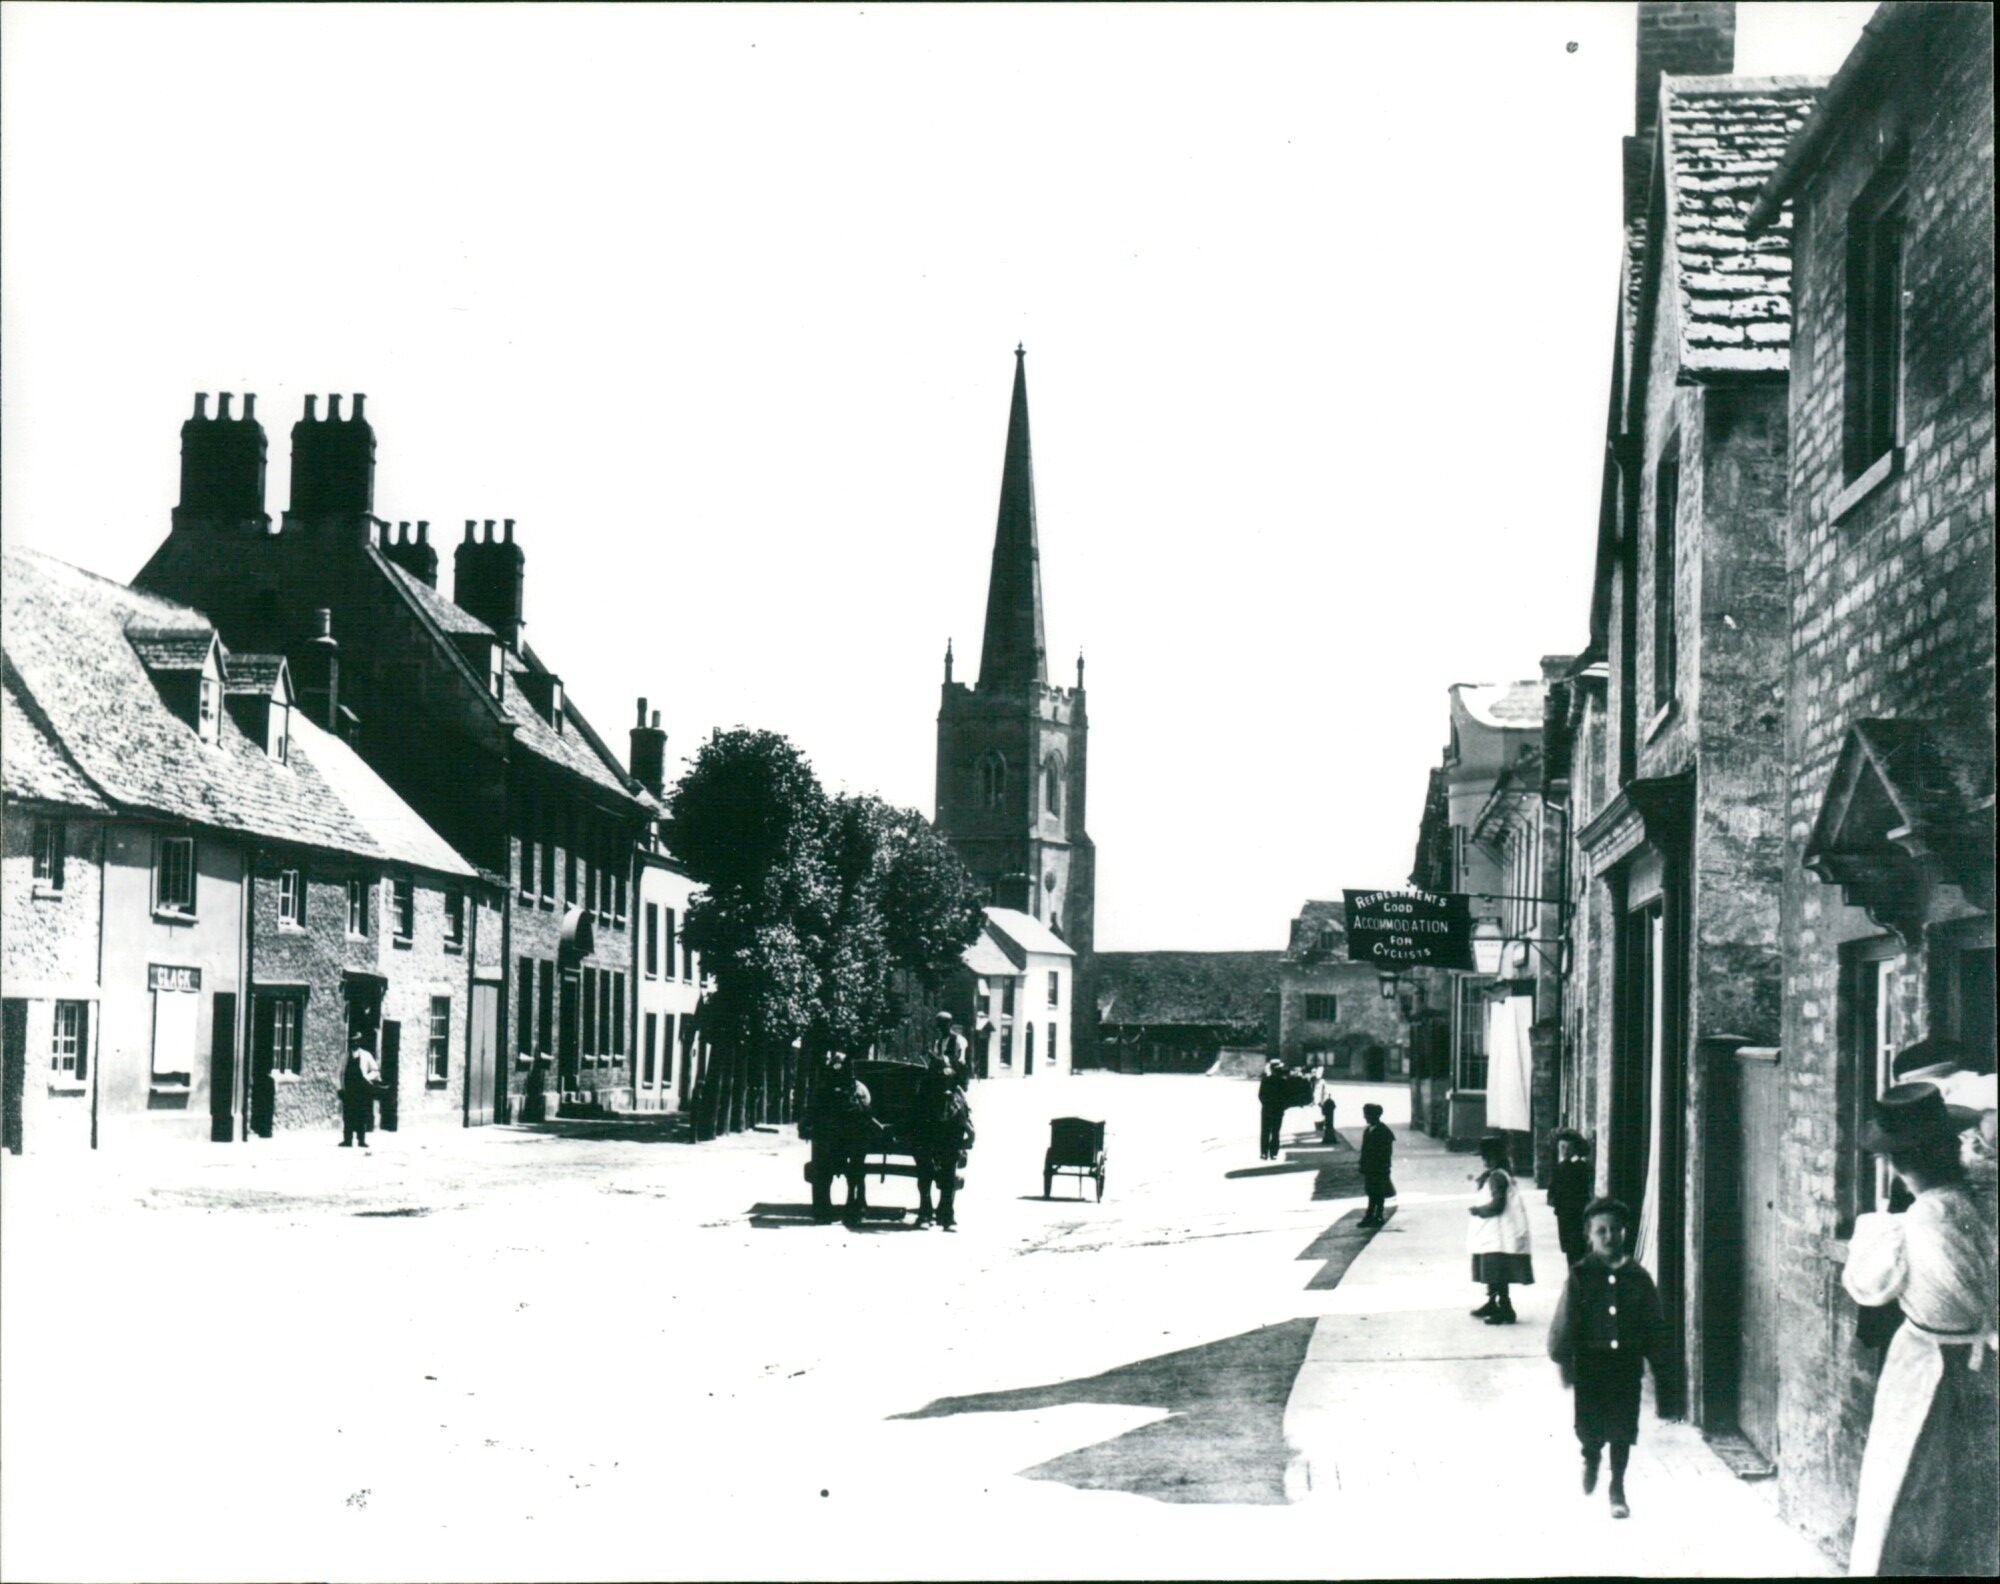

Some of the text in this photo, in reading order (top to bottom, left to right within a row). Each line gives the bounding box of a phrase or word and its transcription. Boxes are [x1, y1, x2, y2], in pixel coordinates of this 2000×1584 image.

[1353, 915, 1449, 933] ACCOMMODATION
[1390, 935, 1413, 946] FOR
[1372, 942, 1432, 959] CYCLISTS
